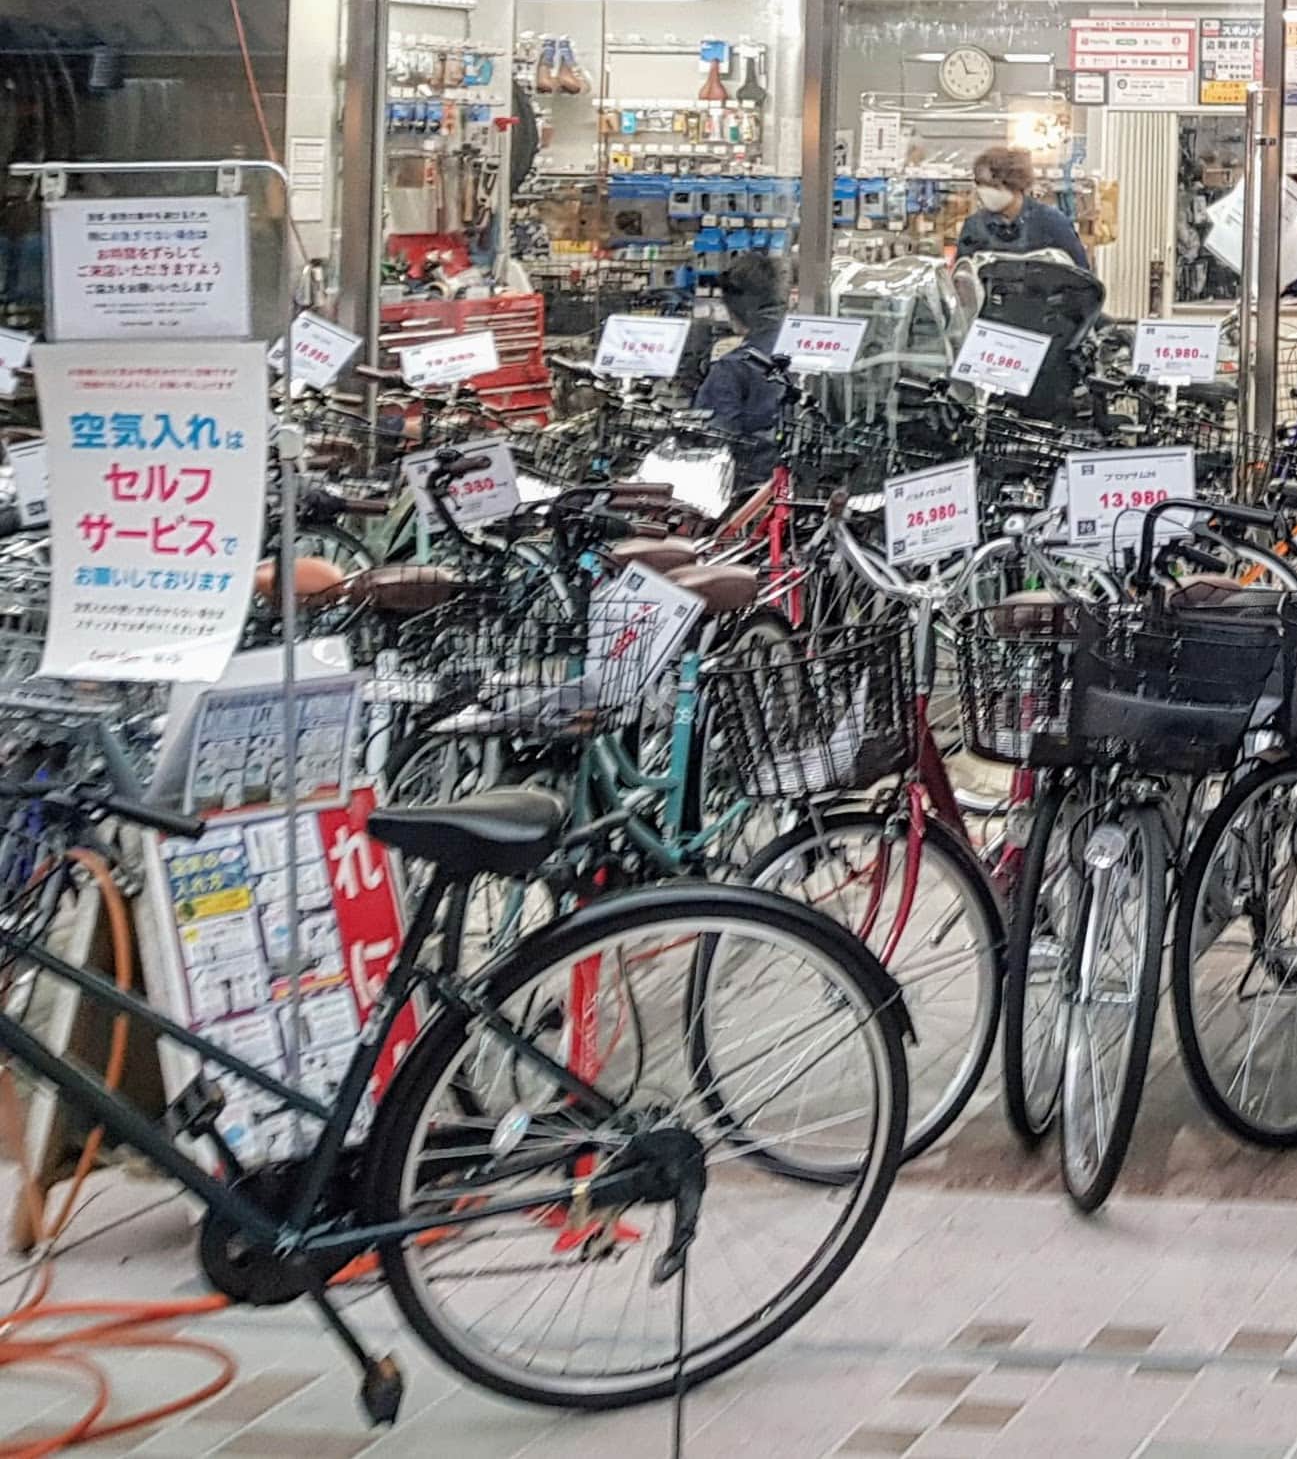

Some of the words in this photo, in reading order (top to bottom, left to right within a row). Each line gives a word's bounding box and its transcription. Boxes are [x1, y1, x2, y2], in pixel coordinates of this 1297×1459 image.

[1155, 347, 1199, 361] 16,980
[70, 411, 244, 450] 空気入れは
[104, 463, 212, 504] セルフ
[1098, 489, 1168, 510] 13,980
[77, 513, 238, 556] サービスで
[74, 566, 232, 592] お願いしております
